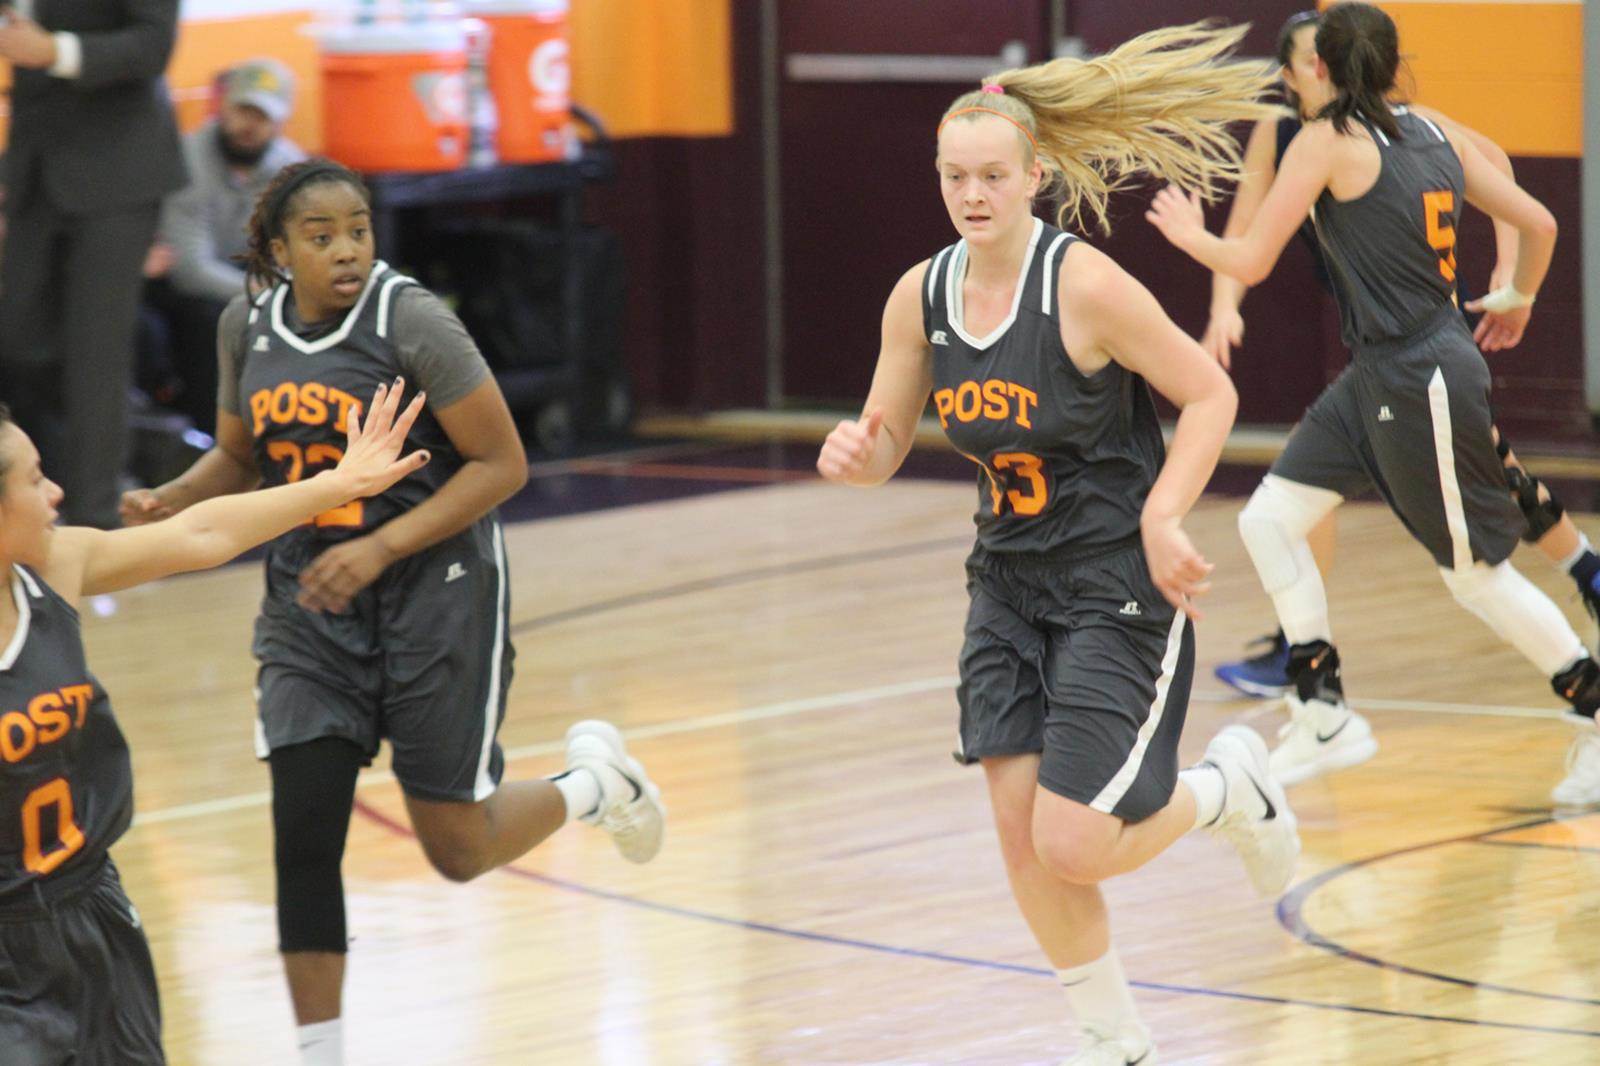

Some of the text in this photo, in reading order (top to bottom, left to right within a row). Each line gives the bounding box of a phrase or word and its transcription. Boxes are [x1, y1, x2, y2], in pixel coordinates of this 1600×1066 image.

[1422, 190, 1457, 283] 5
[250, 381, 363, 437] POST
[934, 378, 1038, 430] POST
[0, 684, 93, 764] OST
[21, 777, 85, 875] 0
